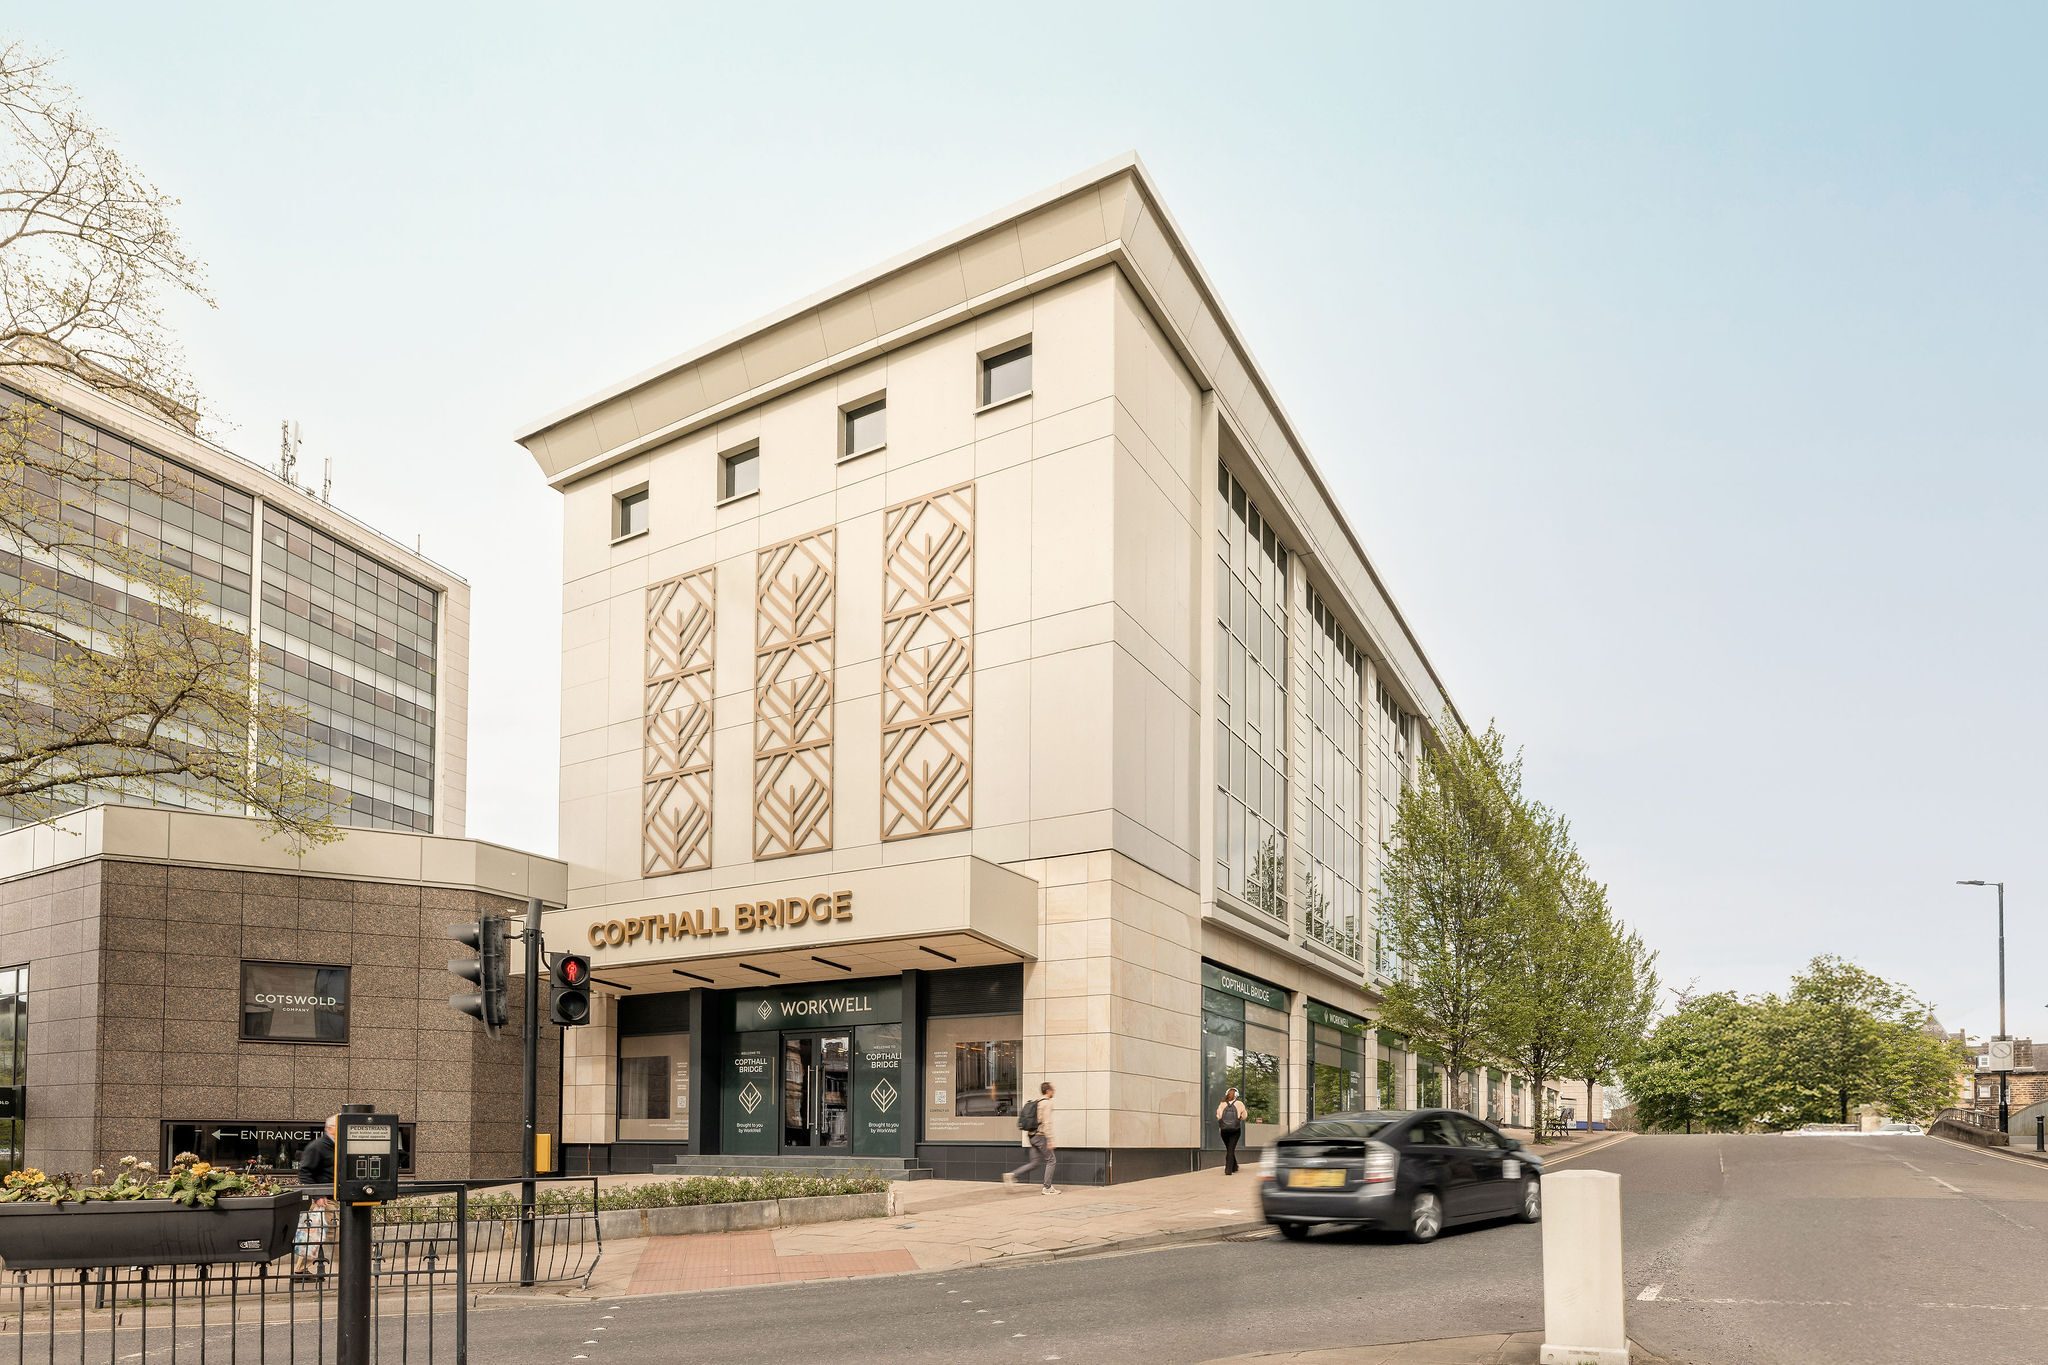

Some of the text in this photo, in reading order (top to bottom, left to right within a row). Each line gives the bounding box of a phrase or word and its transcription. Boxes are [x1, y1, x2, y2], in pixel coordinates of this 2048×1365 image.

[587, 890, 853, 948] COPTHALL BRIDGE
[1221, 976, 1270, 1002] COPTHALL BRIDGE
[255, 993, 336, 1006] COTSWOLD
[780, 996, 872, 1017] WORKWELL
[734, 1058, 767, 1066] COPTHALL
[871, 1060, 899, 1069] BRIDGE
[739, 1065, 763, 1073] BRIDGE
[240, 1130, 312, 1141] ENTRANCE
